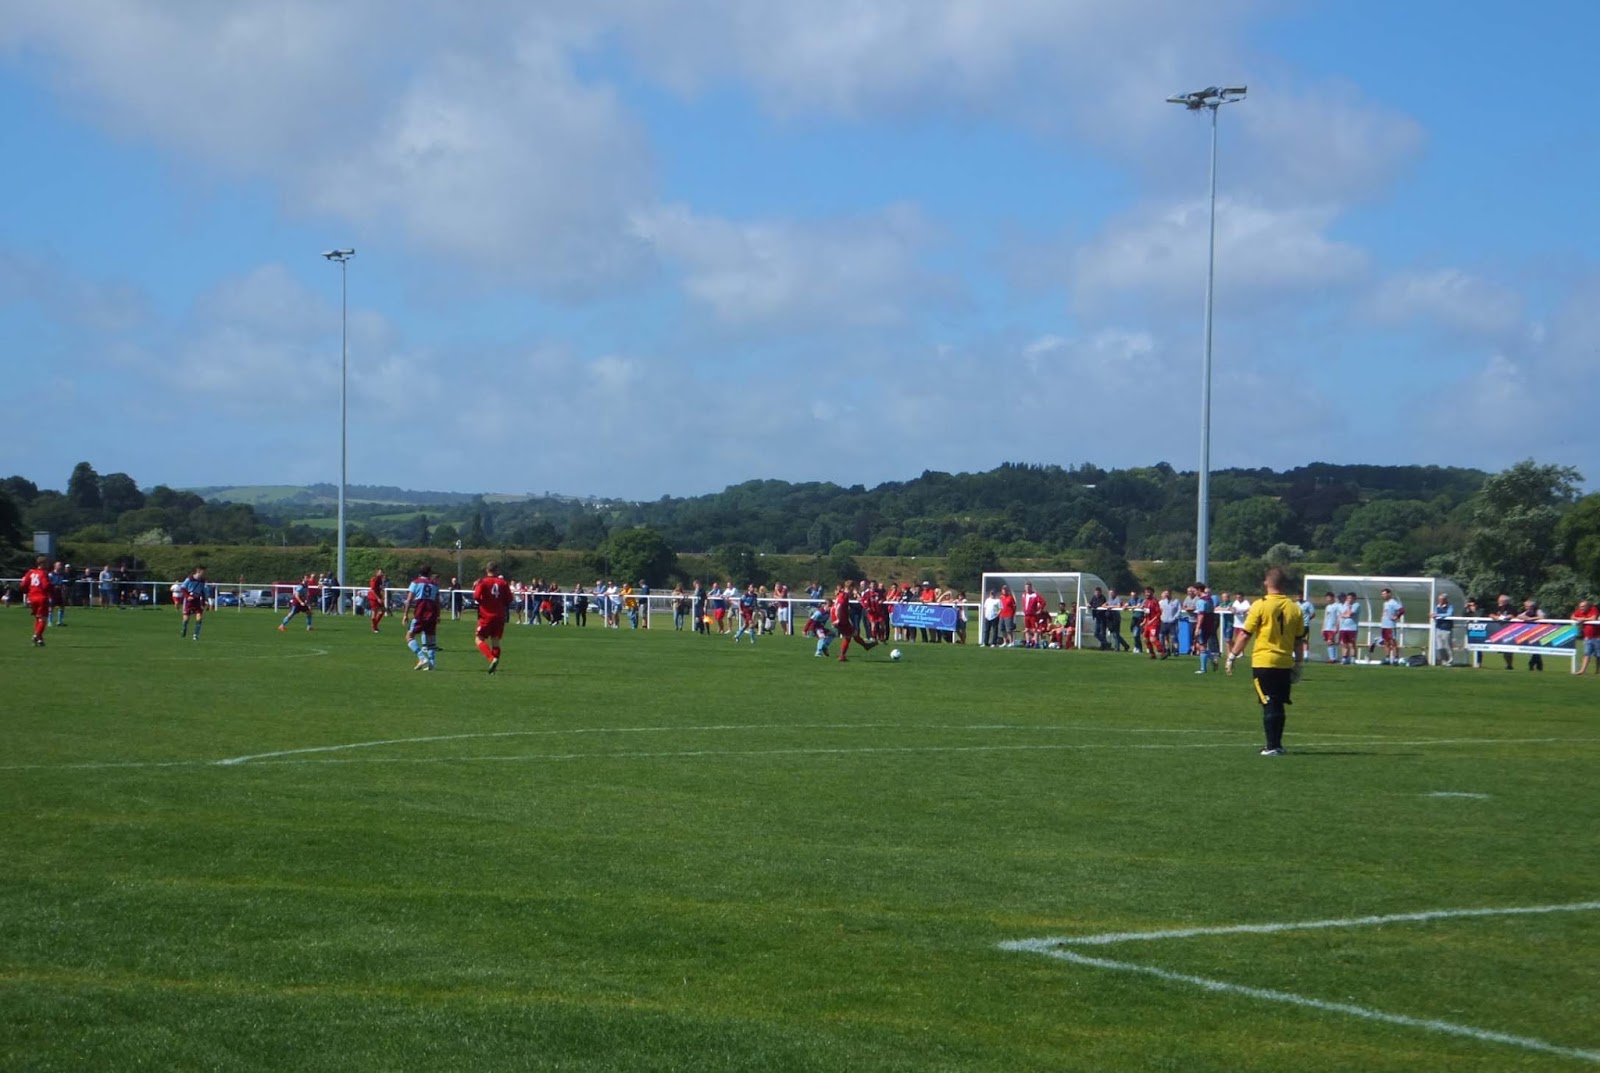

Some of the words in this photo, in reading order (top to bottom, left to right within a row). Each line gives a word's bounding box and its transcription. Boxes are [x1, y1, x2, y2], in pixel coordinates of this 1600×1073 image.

[30, 573, 40, 587] 16
[491, 583, 500, 599] 4
[1277, 611, 1284, 635] 1
